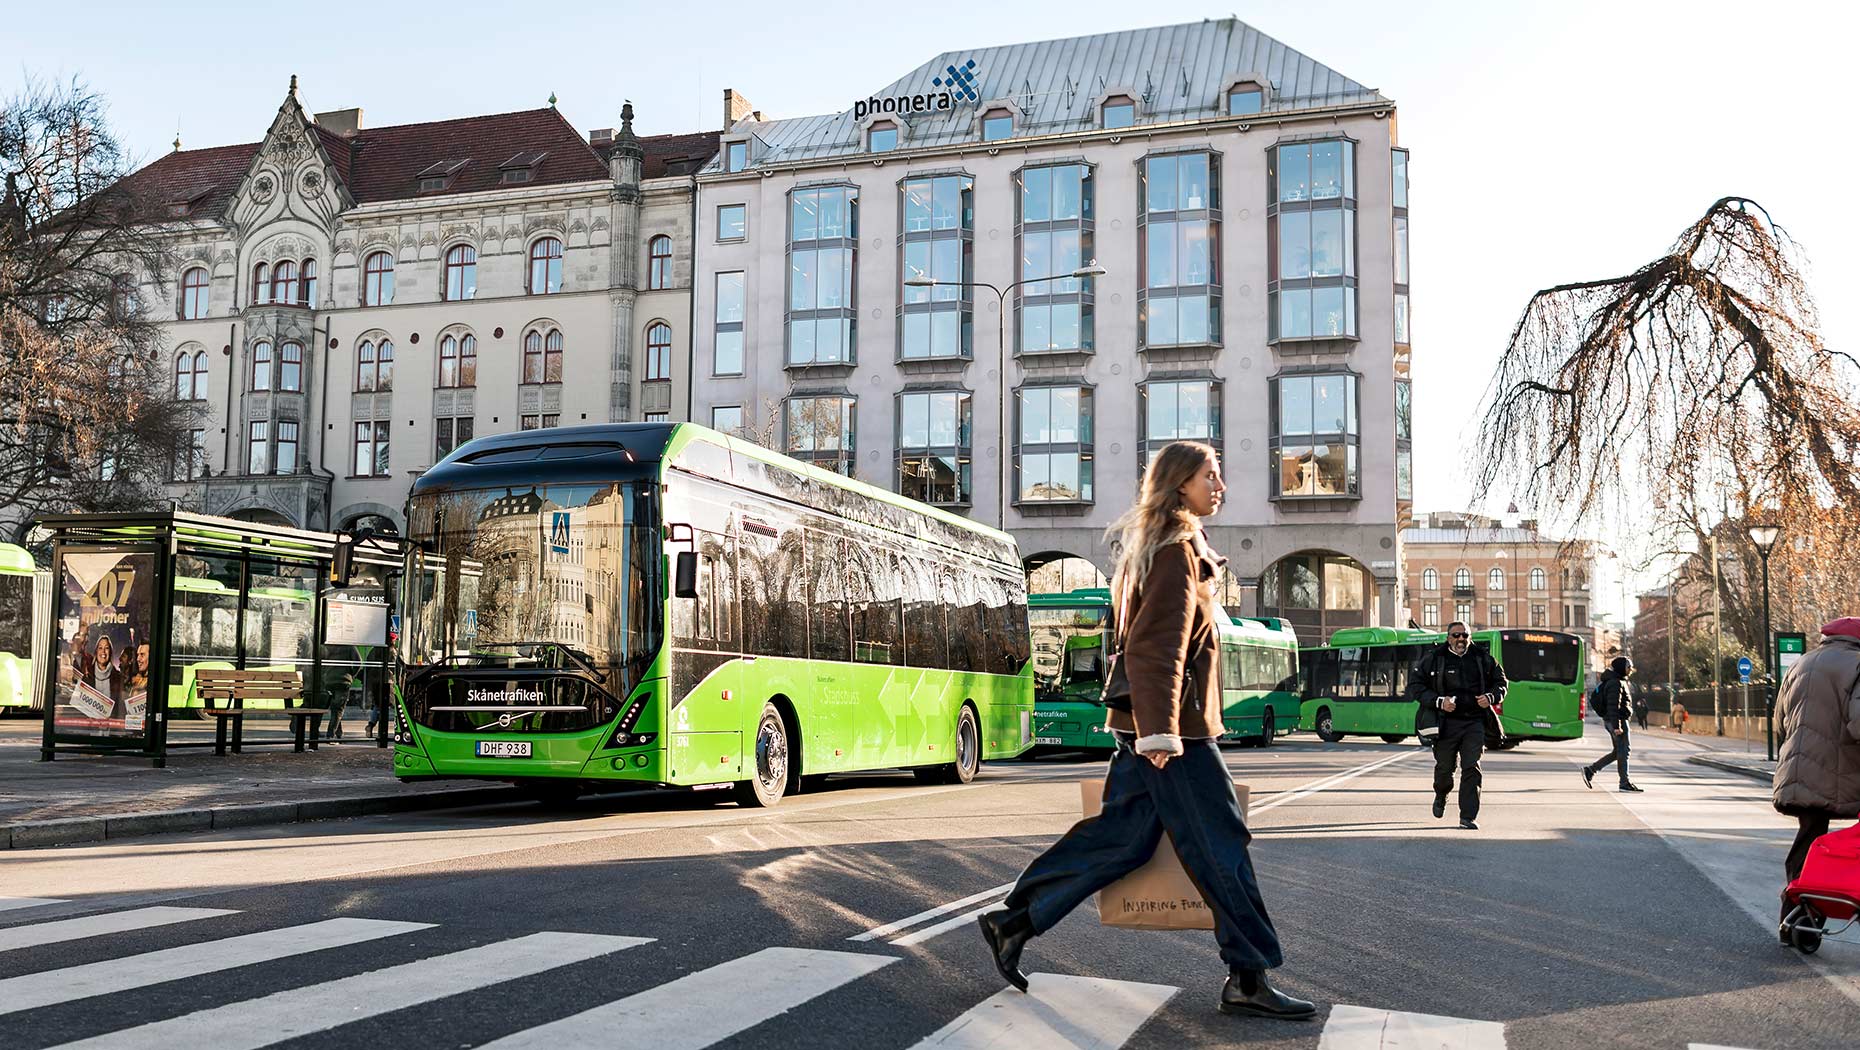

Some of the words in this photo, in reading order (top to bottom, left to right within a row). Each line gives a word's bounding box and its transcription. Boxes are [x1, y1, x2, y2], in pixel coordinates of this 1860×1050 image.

[854, 90, 951, 121] phonera
[82, 607, 129, 627] miljoner
[1786, 643, 1793, 651] B
[467, 688, 544, 701] Skånetrafiken
[484, 743, 503, 754] DHF
[506, 743, 527, 755] 938
